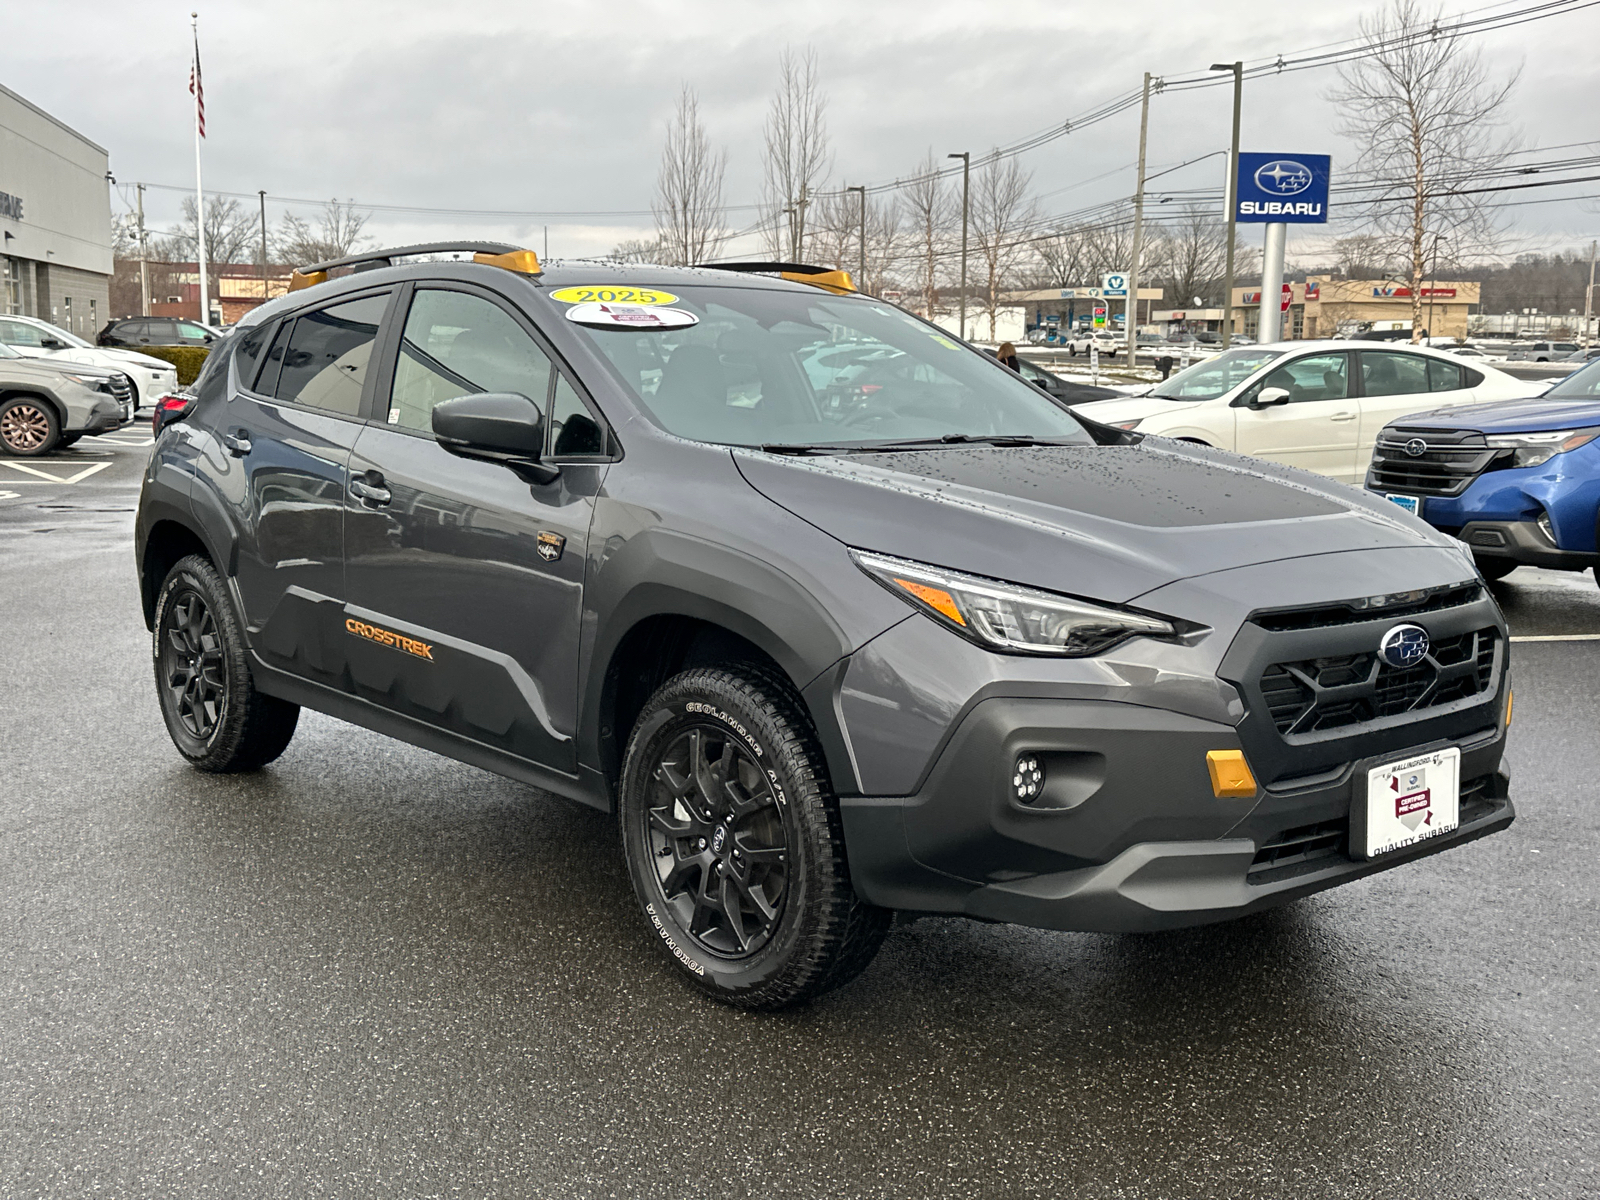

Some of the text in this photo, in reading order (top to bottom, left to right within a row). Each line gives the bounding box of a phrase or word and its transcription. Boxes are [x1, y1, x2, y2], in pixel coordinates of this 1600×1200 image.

[1240, 201, 1321, 216] SUBARU
[577, 290, 657, 302] 2025
[1281, 292, 1291, 304] TOP
[345, 618, 433, 660] CROSSTREK
[685, 702, 763, 757] GEOLANDAR
[767, 769, 786, 805] A/T
[1373, 823, 1456, 856] QUALITY SUBARU
[646, 903, 704, 976] YOKOHAMA
